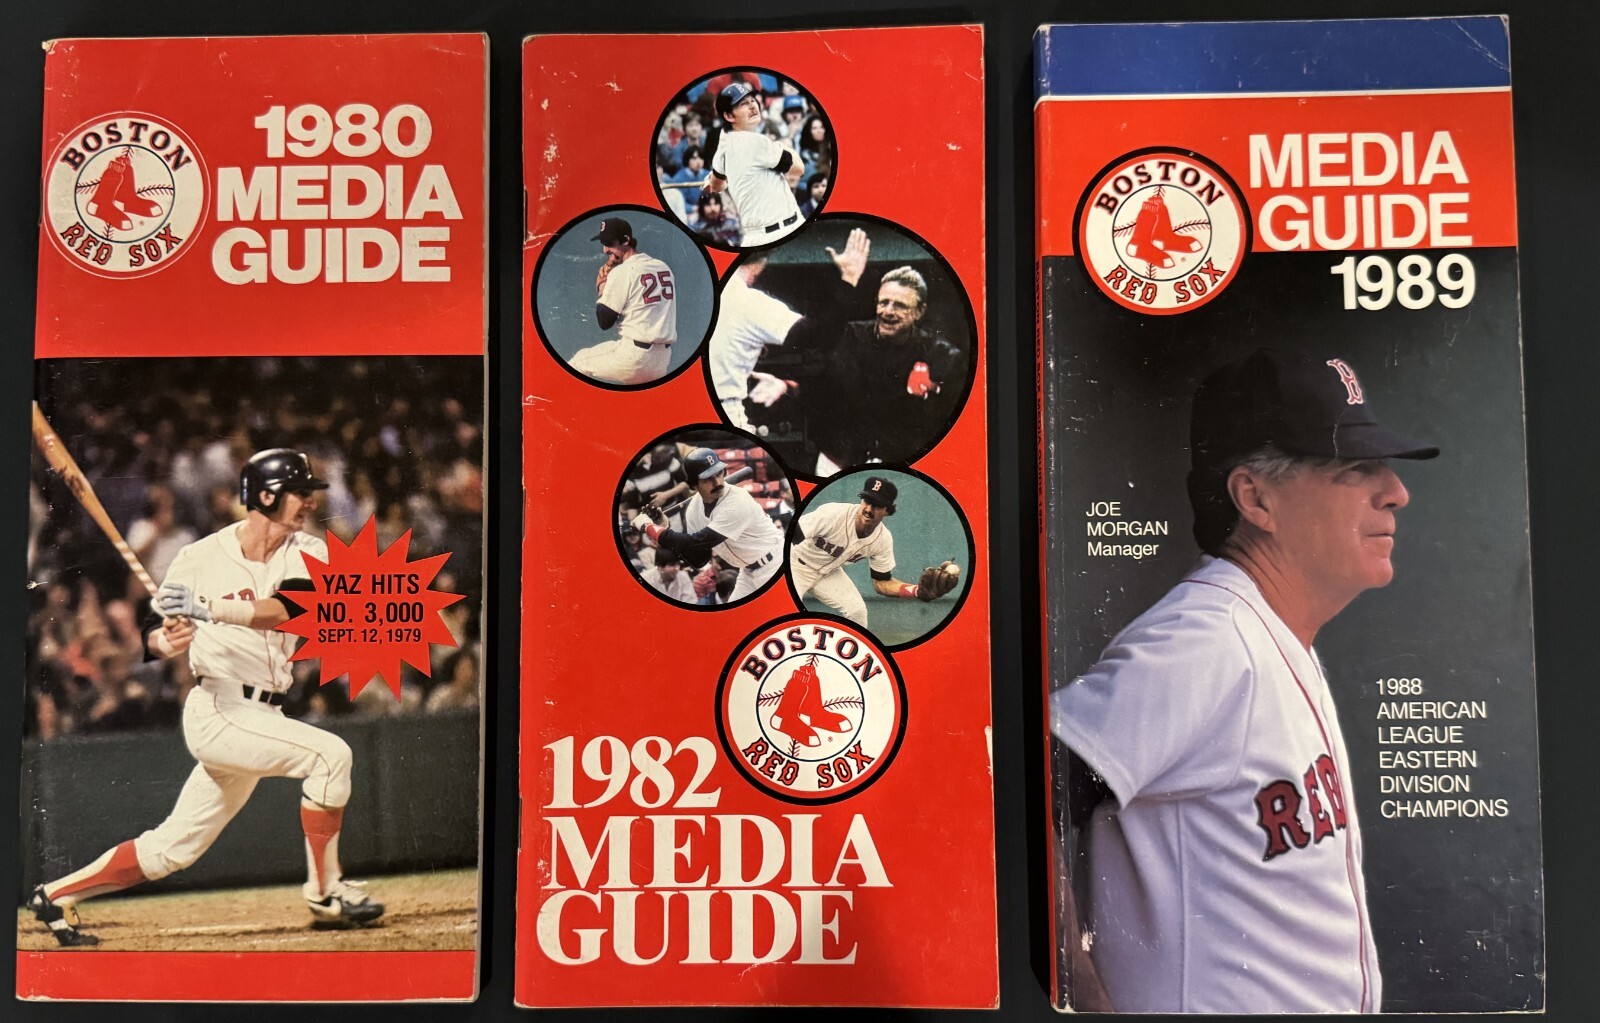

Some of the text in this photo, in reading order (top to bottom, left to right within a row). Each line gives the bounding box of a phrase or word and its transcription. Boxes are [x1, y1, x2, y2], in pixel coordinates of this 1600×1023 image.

[60, 121, 192, 172] BOSTON
[254, 104, 433, 158] 1980
[1249, 130, 1470, 189] MEDIA
[217, 164, 464, 222] MEDIA
[1094, 161, 1224, 215] BOSTON
[60, 221, 184, 268] RED SOX
[1258, 192, 1473, 252] GUIDE
[212, 227, 451, 286] GUIDE
[640, 271, 674, 304] 25
[1104, 257, 1226, 305] RED SOX
[1330, 253, 1477, 311] 1989
[1326, 358, 1364, 405] B
[871, 480, 882, 491] B
[1085, 501, 1121, 517] JOE
[1087, 520, 1168, 537] MORGAN
[1087, 541, 1160, 560] Manager
[322, 574, 420, 595] YAZ HITS
[317, 602, 424, 626] NO. 3,000
[318, 628, 422, 645] SEPT. 12, 1979
[740, 626, 883, 683] BOSTON
[1376, 678, 1423, 695] 1988
[1376, 701, 1487, 720] AMERICAN
[1378, 726, 1464, 744] LEAGUE
[542, 735, 722, 809] 1982
[742, 737, 875, 789] RED SOX
[1379, 750, 1477, 769] EASTERN
[1380, 774, 1471, 793] DIVISION
[1380, 799, 1509, 819] CHAMPIONS
[541, 814, 894, 888] MEDIA
[536, 889, 858, 966] GUIDE
